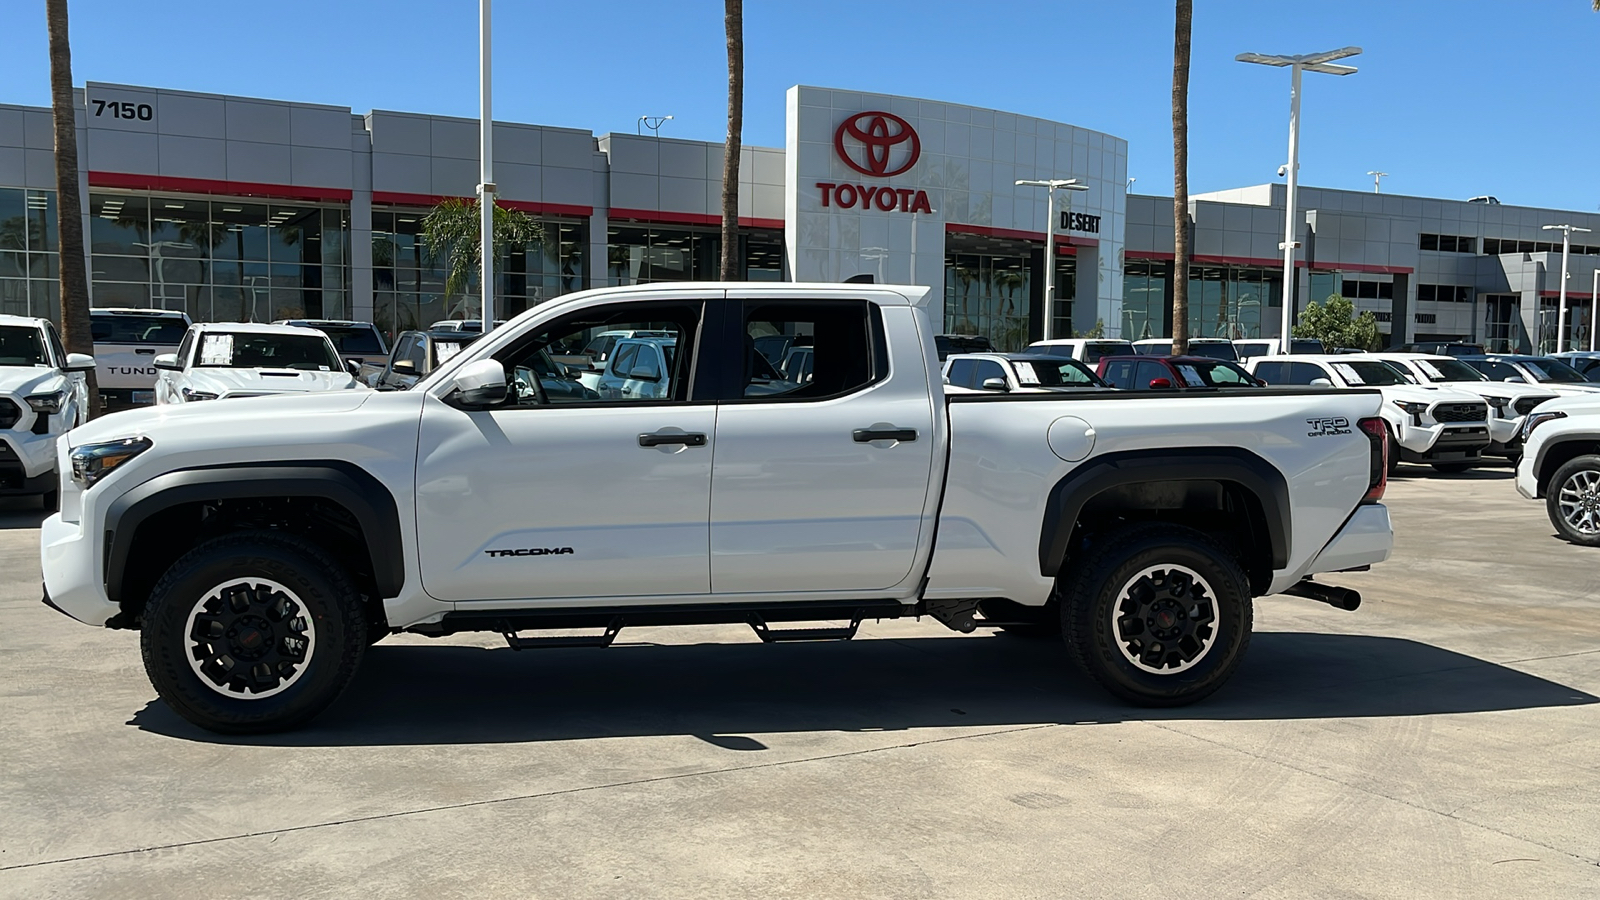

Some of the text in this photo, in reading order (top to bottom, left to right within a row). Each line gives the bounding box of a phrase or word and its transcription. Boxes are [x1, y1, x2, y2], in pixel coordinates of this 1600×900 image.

[92, 99, 153, 121] 7150
[816, 183, 932, 214] TOYOTA
[1061, 211, 1101, 233] DESERT
[1306, 416, 1350, 432] TRD
[485, 547, 574, 557] TACOMA
